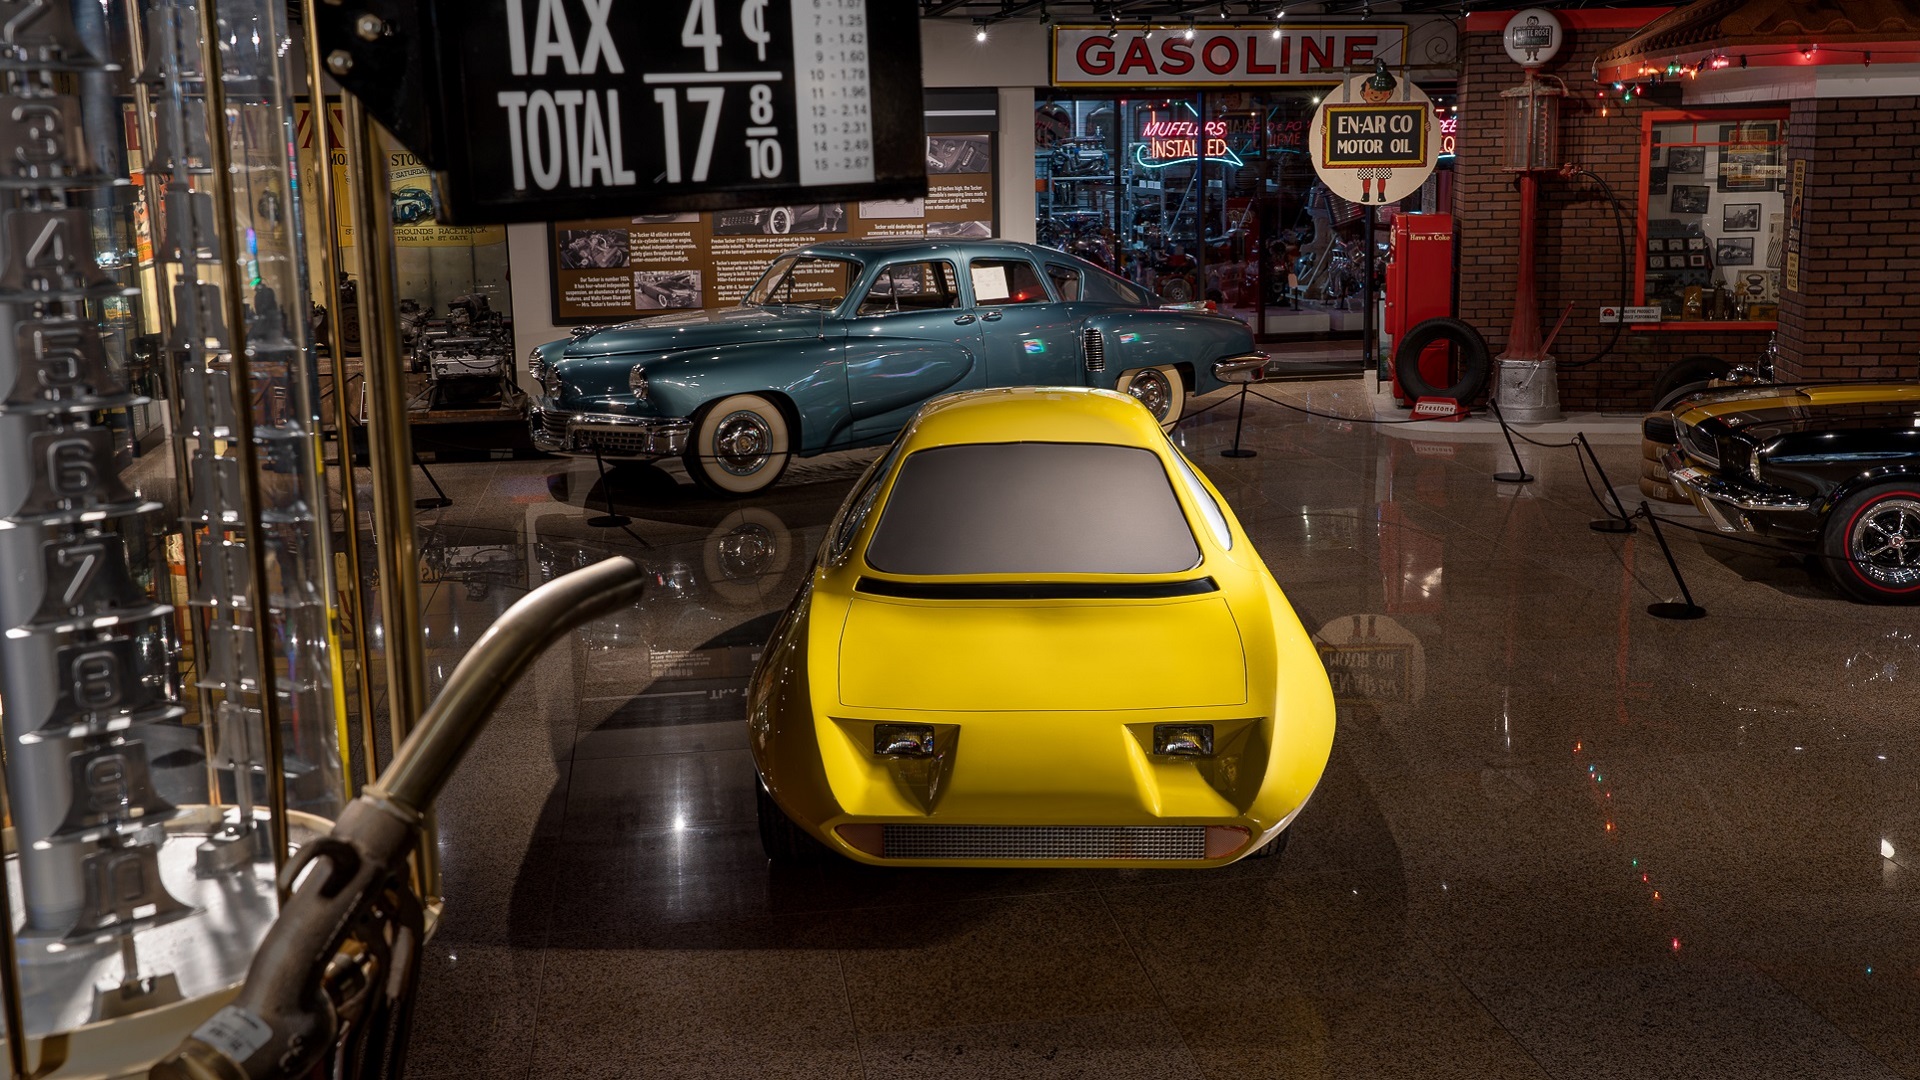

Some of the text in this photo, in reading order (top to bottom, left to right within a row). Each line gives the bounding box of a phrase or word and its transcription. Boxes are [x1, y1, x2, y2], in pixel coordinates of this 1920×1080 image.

[814, 14, 863, 27] 7 1.25
[681, 0, 722, 72] 4
[815, 32, 864, 44] 8 1.42
[1534, 29, 1548, 37] ROSE
[816, 50, 865, 62] 9 1.60
[1076, 35, 1378, 75] GASOLINE
[810, 69, 866, 81] 10 1.78
[811, 87, 867, 98] 11 1.96
[750, 84, 773, 125] 8
[812, 105, 867, 117] 12 2.14
[813, 122, 868, 135] 13 2.31
[1338, 115, 1413, 134] EN-AR CO
[11, 103, 63, 165] 3
[498, 87, 725, 190] TOTAL 17
[814, 140, 869, 152] 14 2.49
[1152, 137, 1227, 158] INSTALED
[1337, 138, 1413, 154] MOTOR OIL
[745, 138, 783, 179] 10
[814, 157, 870, 170] 15 2.67
[438, 226, 488, 235] RACETRACK
[26, 217, 76, 276] 4
[33, 327, 84, 387] 5
[1416, 403, 1455, 413] Firestone
[46, 437, 98, 498] 6
[57, 544, 105, 603] 7
[71, 650, 122, 708] 8
